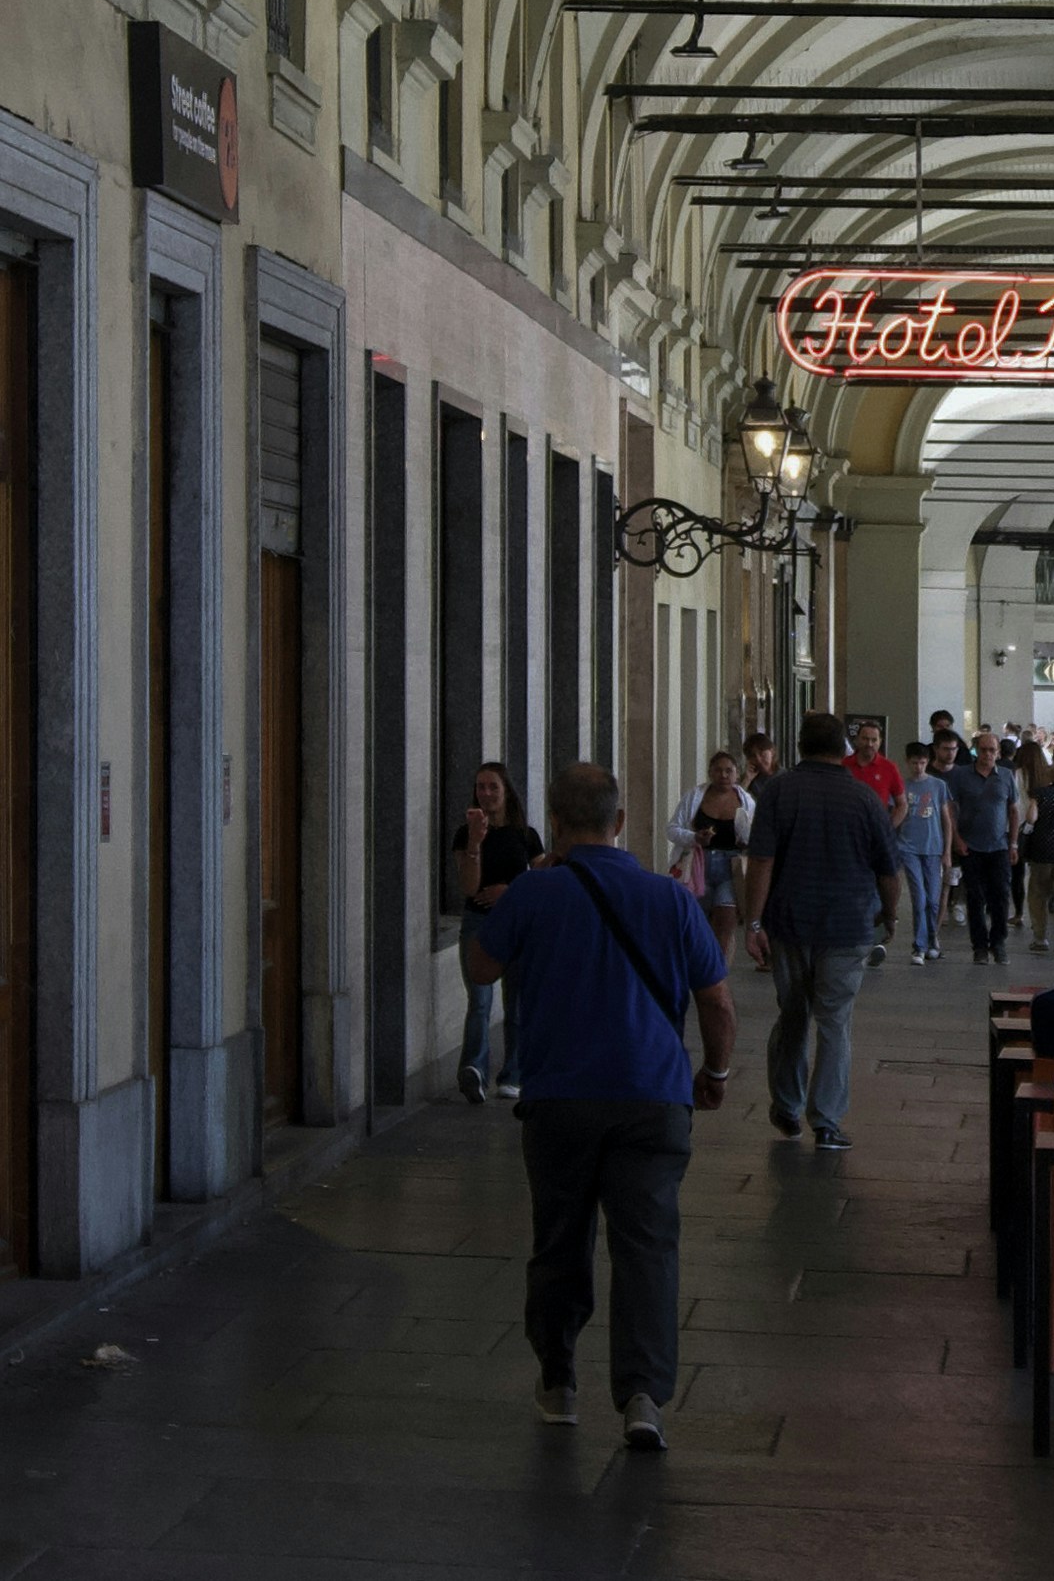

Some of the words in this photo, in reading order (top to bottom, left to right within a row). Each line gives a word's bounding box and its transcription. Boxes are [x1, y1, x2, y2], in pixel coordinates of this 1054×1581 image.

[171, 74, 193, 121] Street
[194, 91, 216, 135] coffee
[806, 288, 1022, 366] Hotel
